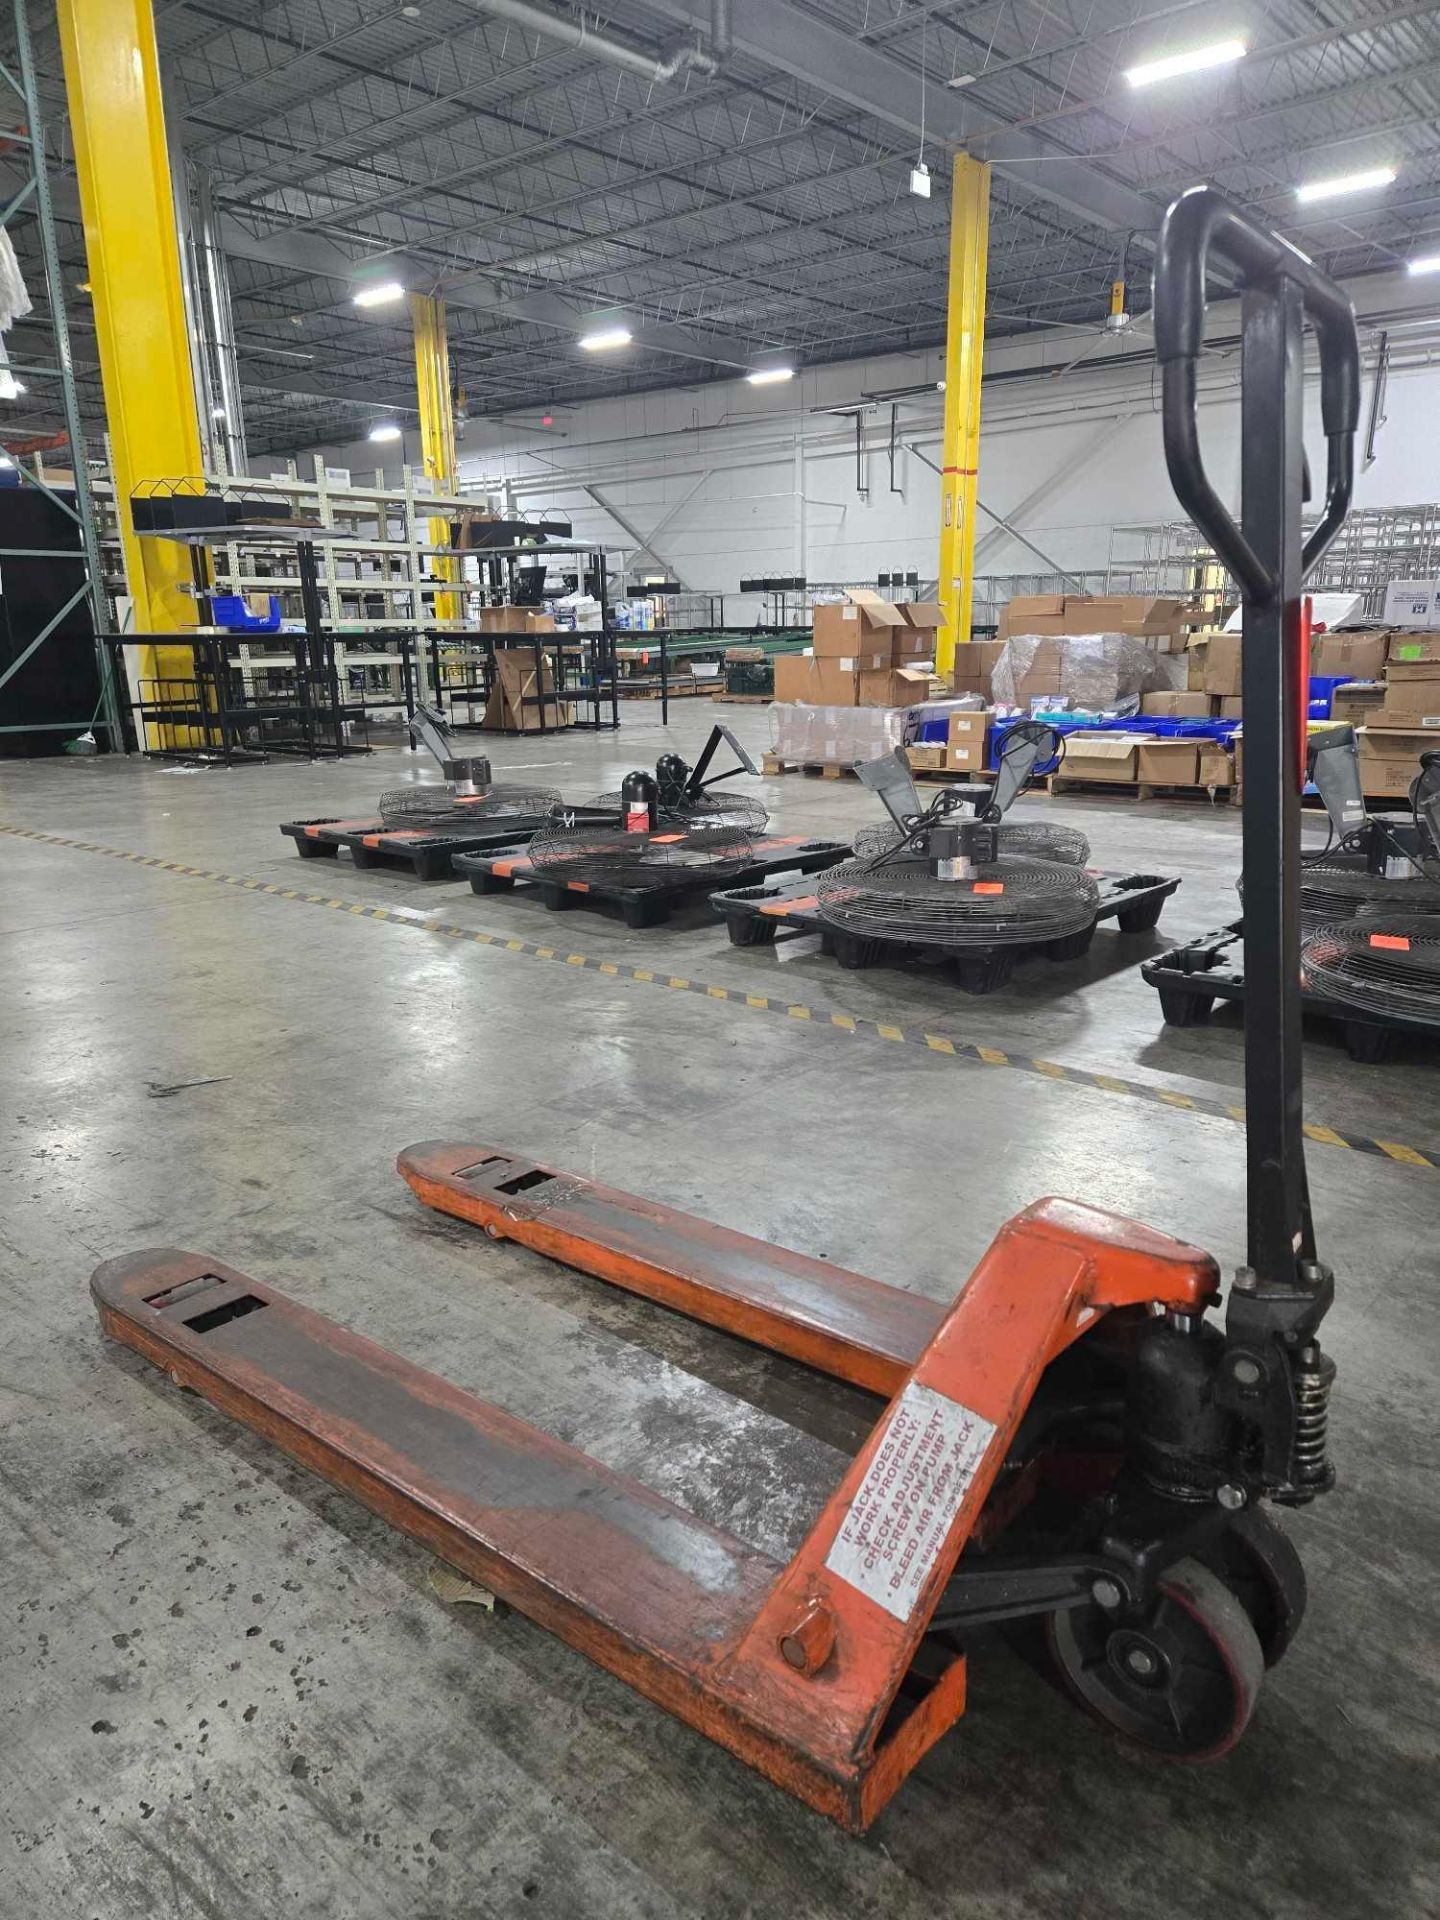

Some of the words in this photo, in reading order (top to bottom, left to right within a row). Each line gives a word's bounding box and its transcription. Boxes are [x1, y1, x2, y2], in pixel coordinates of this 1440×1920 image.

[841, 1527, 854, 1543] IF
[851, 1485, 874, 1524] JACK
[871, 1441, 894, 1481] DOES
[890, 1408, 910, 1439] NOT
[855, 1501, 881, 1546] WORK
[878, 1418, 920, 1497] PROPERLY:
[864, 1515, 894, 1568] CHECK
[890, 1409, 944, 1511] ADJUSTMENT
[882, 1505, 914, 1561] SCREW
[909, 1480, 925, 1504] ON
[923, 1434, 947, 1477] PUMP
[890, 1538, 918, 1588] BLEED
[913, 1508, 932, 1535] AIR
[928, 1463, 954, 1505] FROM
[949, 1420, 973, 1460] JACK
[910, 1567, 923, 1587] SEE
[921, 1520, 945, 1564] MANUAL
